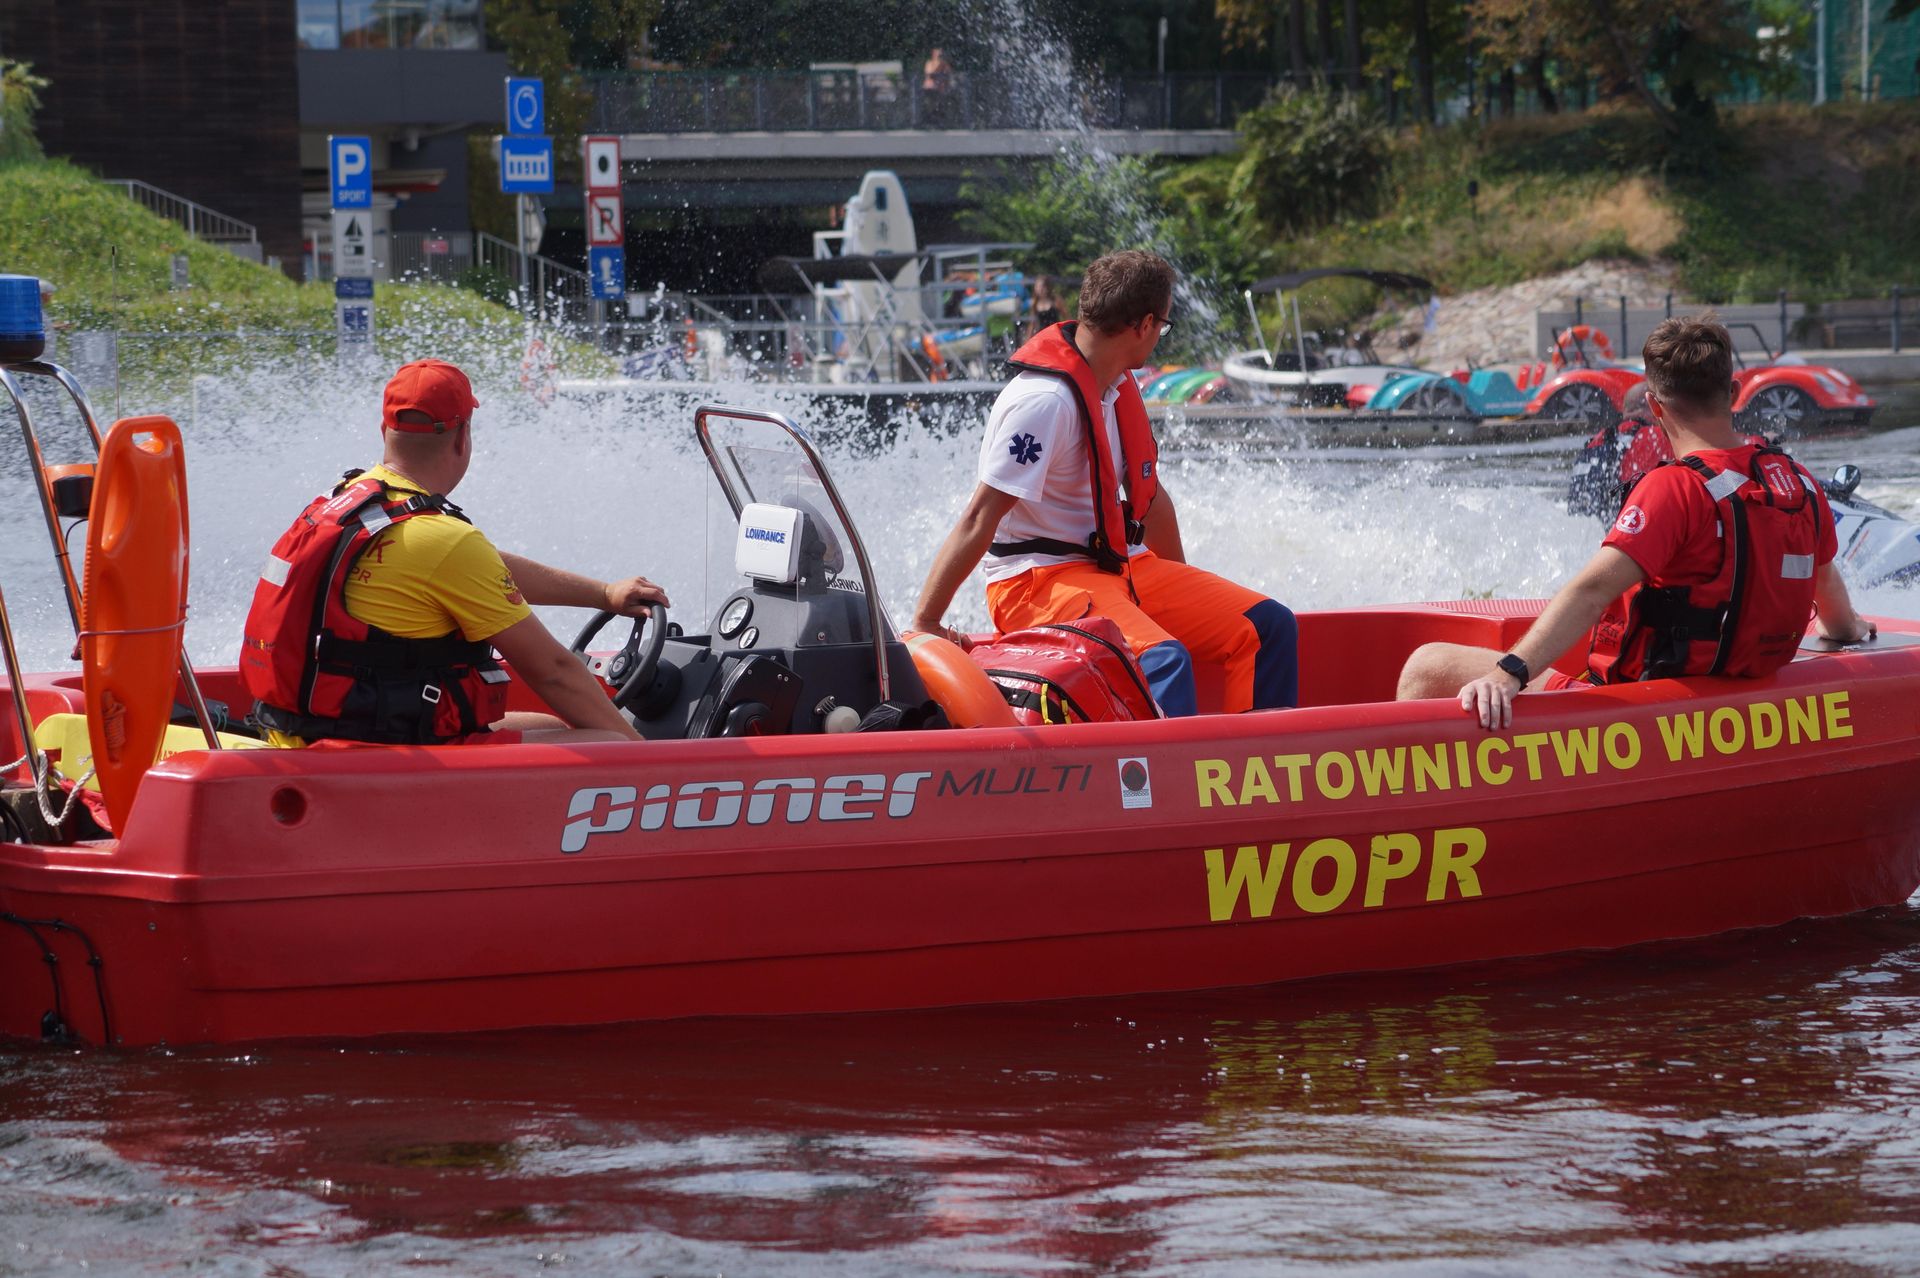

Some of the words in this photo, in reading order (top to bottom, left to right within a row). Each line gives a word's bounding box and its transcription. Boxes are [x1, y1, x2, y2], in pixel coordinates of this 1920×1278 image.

[337, 144, 366, 187] P
[338, 190, 366, 202] SPORT
[745, 527, 785, 543] LOWRANCE
[1195, 722, 1642, 808] RATOWNICTWO
[1656, 691, 1855, 762] WODNE
[561, 771, 932, 853] pioner
[937, 764, 1092, 797] MULTI
[1204, 827, 1488, 922] WOPR
